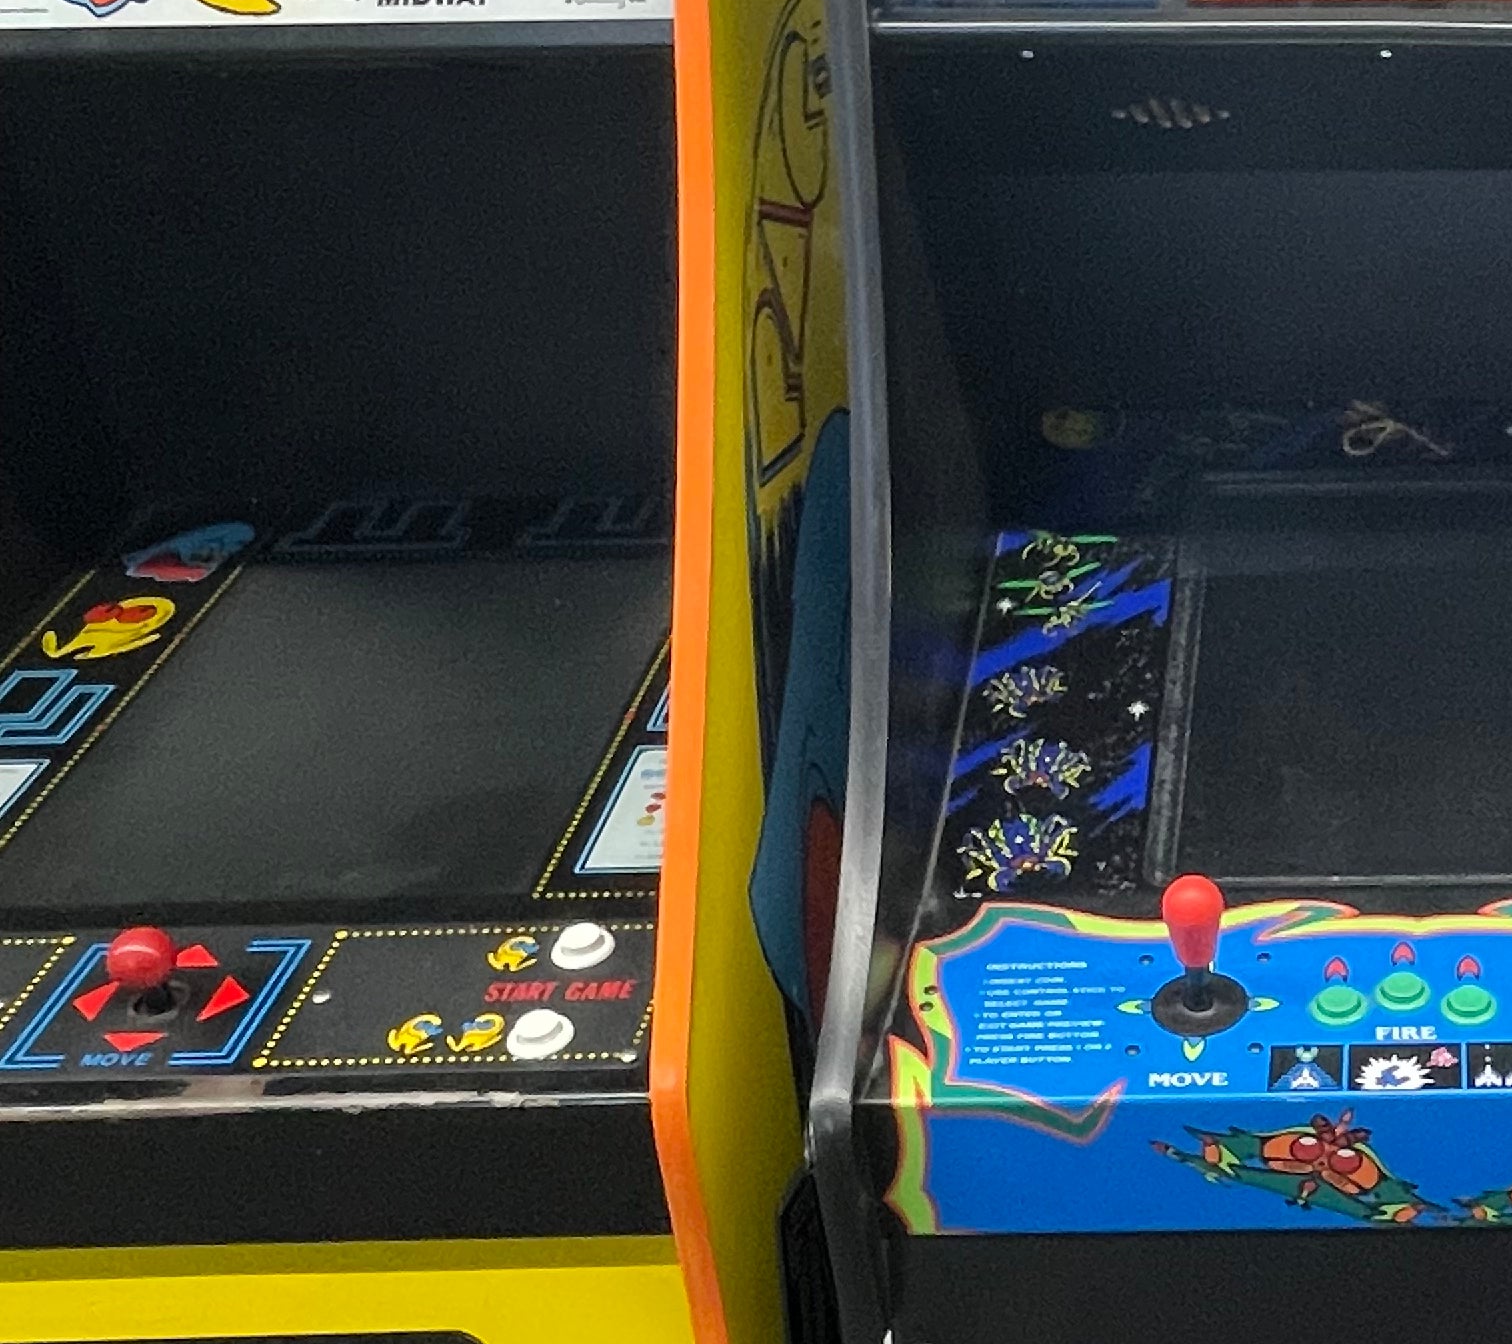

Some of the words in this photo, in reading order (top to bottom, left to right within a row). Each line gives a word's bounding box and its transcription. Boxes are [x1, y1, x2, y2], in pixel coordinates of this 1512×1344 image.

[484, 979, 560, 1003] START
[564, 978, 639, 1001] GAME
[1375, 1026, 1437, 1040] FIRE
[80, 1052, 155, 1067] MOVE
[1147, 1071, 1229, 1087] MOVE
